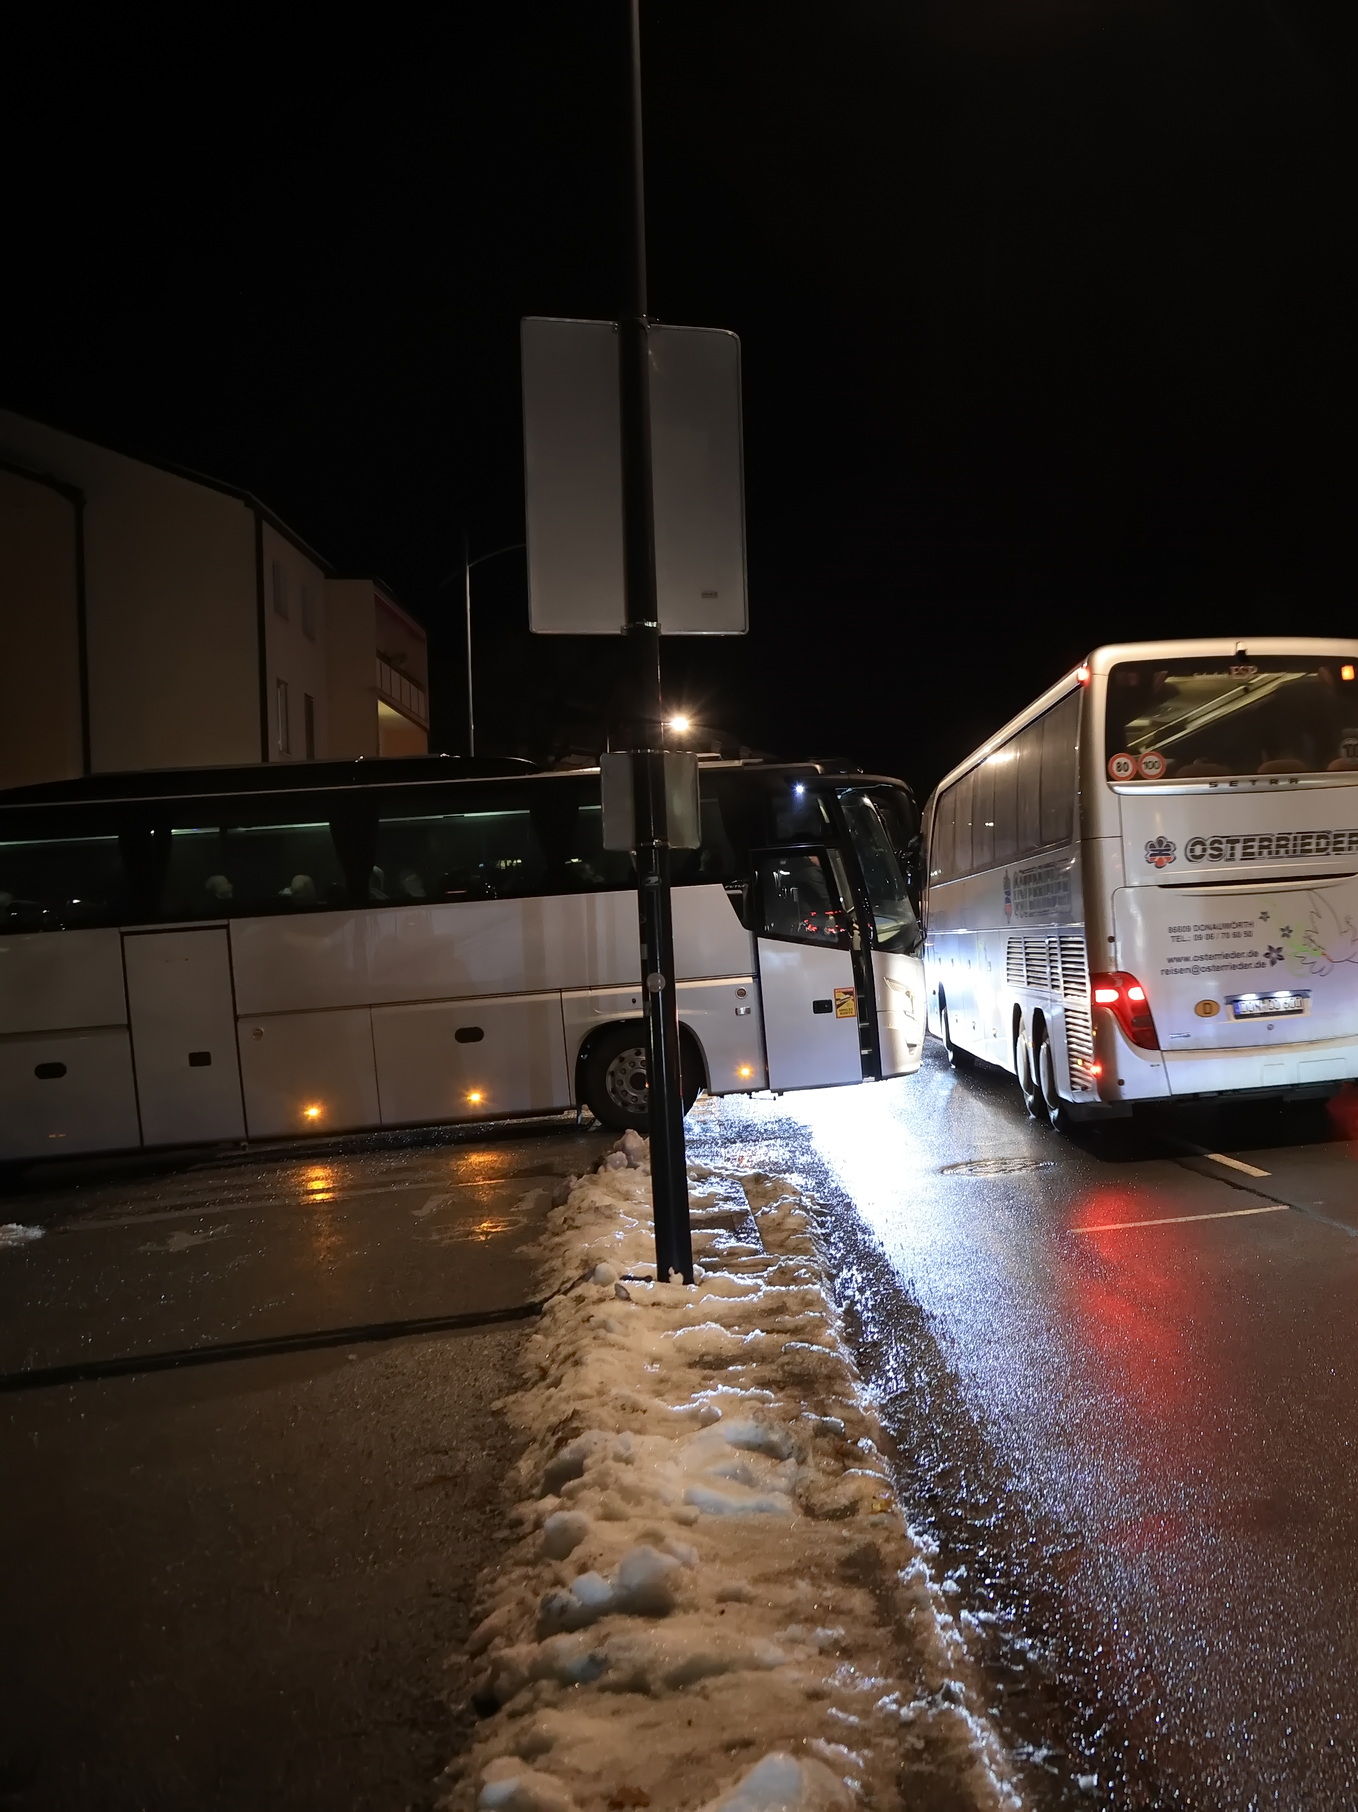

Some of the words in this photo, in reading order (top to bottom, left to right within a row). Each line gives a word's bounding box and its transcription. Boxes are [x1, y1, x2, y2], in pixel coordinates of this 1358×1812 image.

[1115, 761, 1129, 772] 80
[1142, 760, 1160, 770] 100
[1208, 778, 1299, 788] SETRA
[1166, 950, 1259, 964] www.osterrieder.de
[1160, 960, 1267, 975] reisen@osterrieder.de
